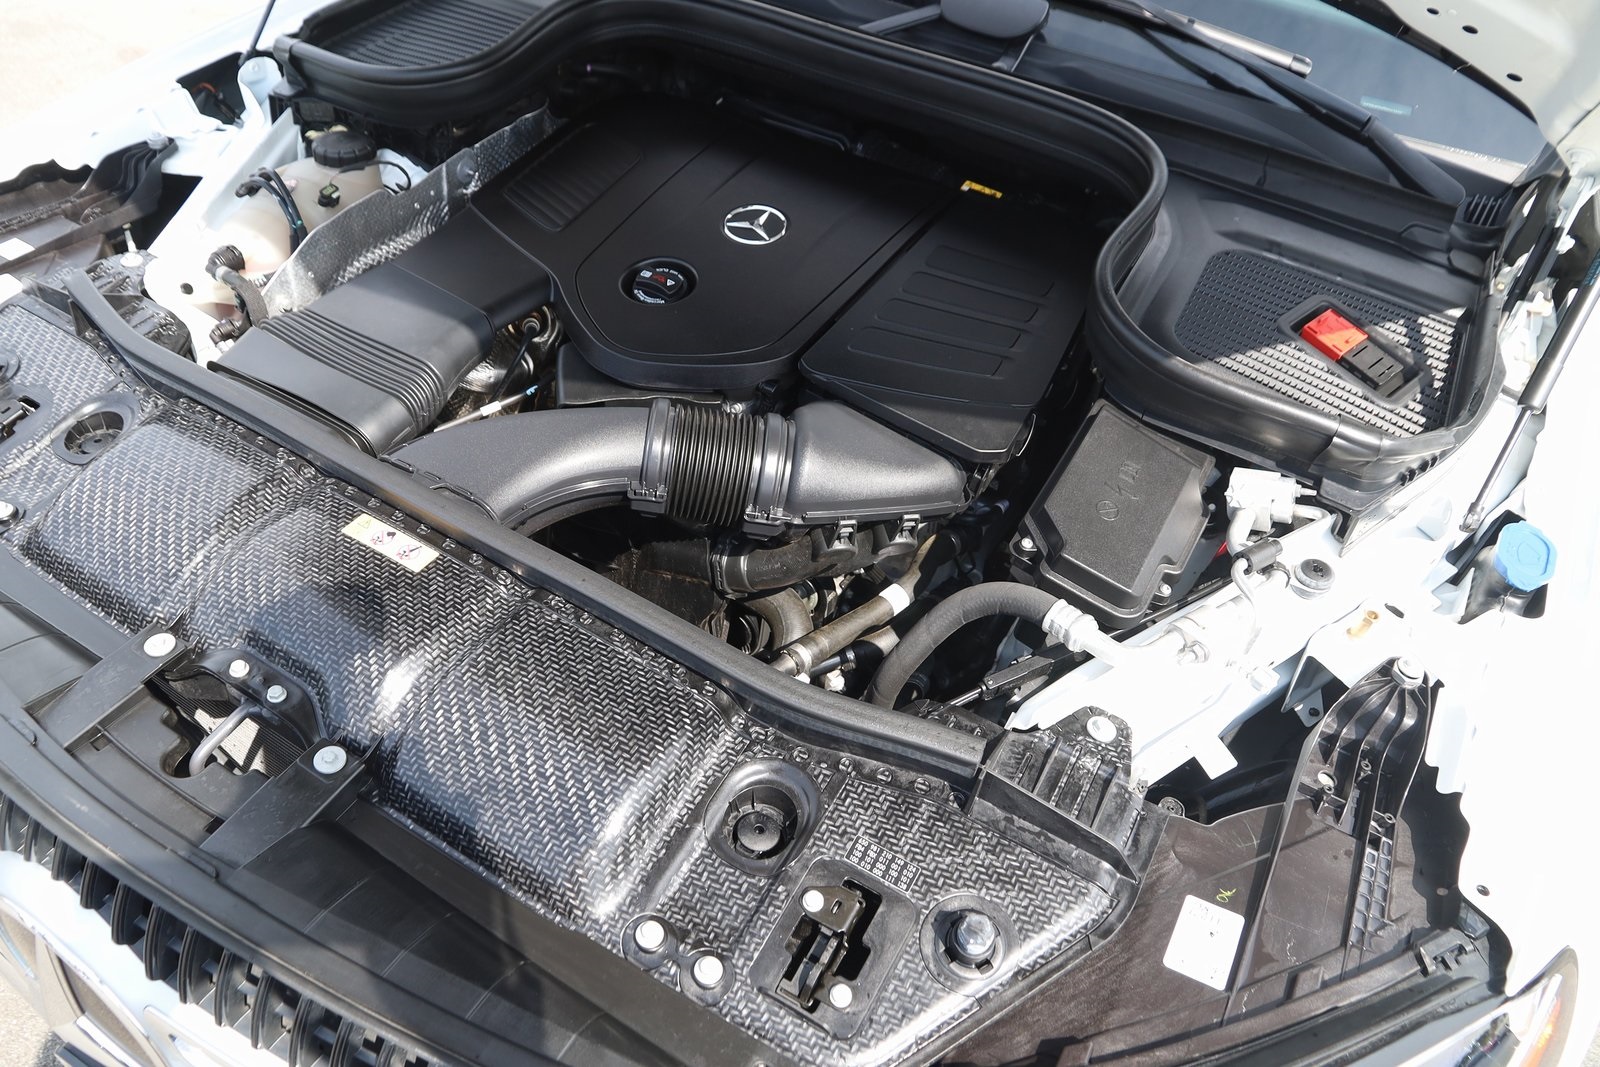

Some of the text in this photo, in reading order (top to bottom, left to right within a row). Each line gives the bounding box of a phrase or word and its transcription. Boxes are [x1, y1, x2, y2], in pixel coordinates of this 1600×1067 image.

[850, 855, 859, 863] 100
[861, 861, 871, 870] 010
[873, 868, 882, 876] 000
[885, 875, 894, 883] 111
[853, 849, 910, 884] 100 101 000 100 101
[879, 857, 889, 865] 011
[891, 863, 901, 872] 001
[903, 869, 913, 878] 010
[882, 851, 892, 859] 210
[907, 864, 916, 873] 124
